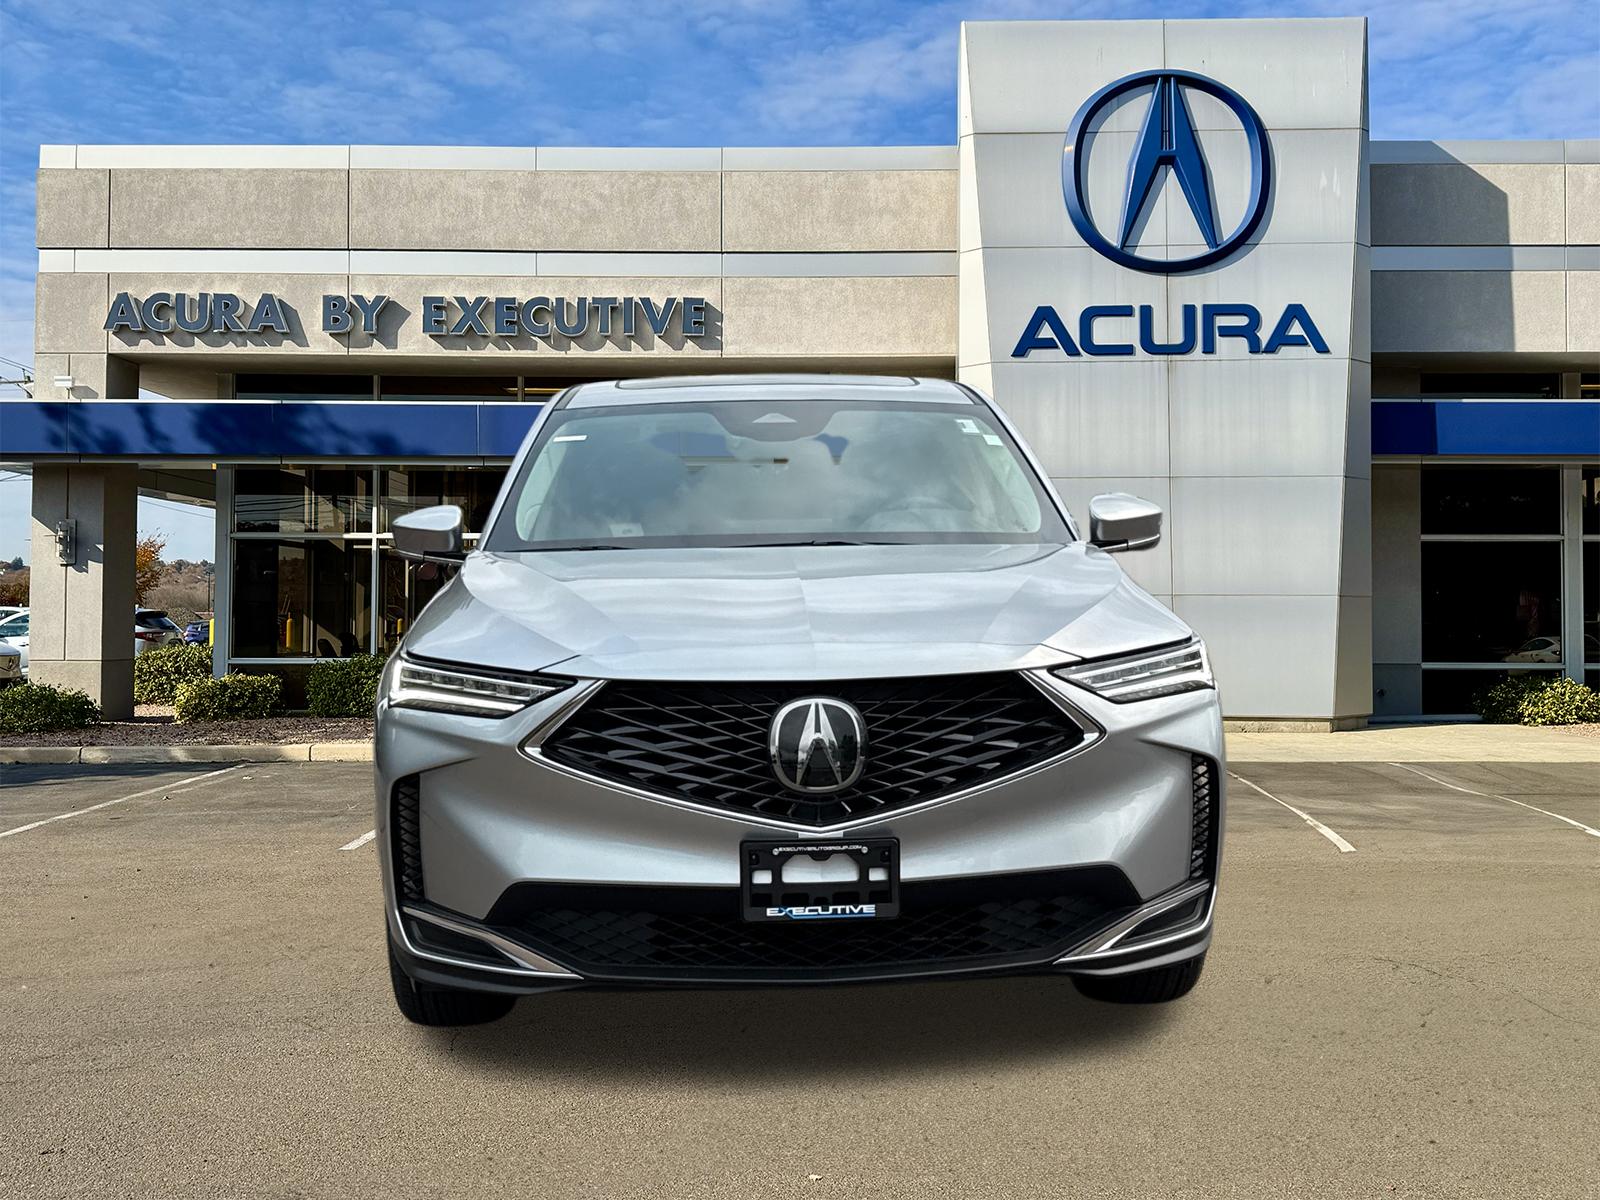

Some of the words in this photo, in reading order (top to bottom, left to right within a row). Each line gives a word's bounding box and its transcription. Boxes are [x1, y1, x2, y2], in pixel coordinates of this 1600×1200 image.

[104, 291, 289, 334] ACURA
[321, 294, 389, 335] BY
[422, 296, 706, 337] EXECUTIVE
[1010, 303, 1331, 357] ACURA
[766, 904, 876, 919] EXECUTIVE
